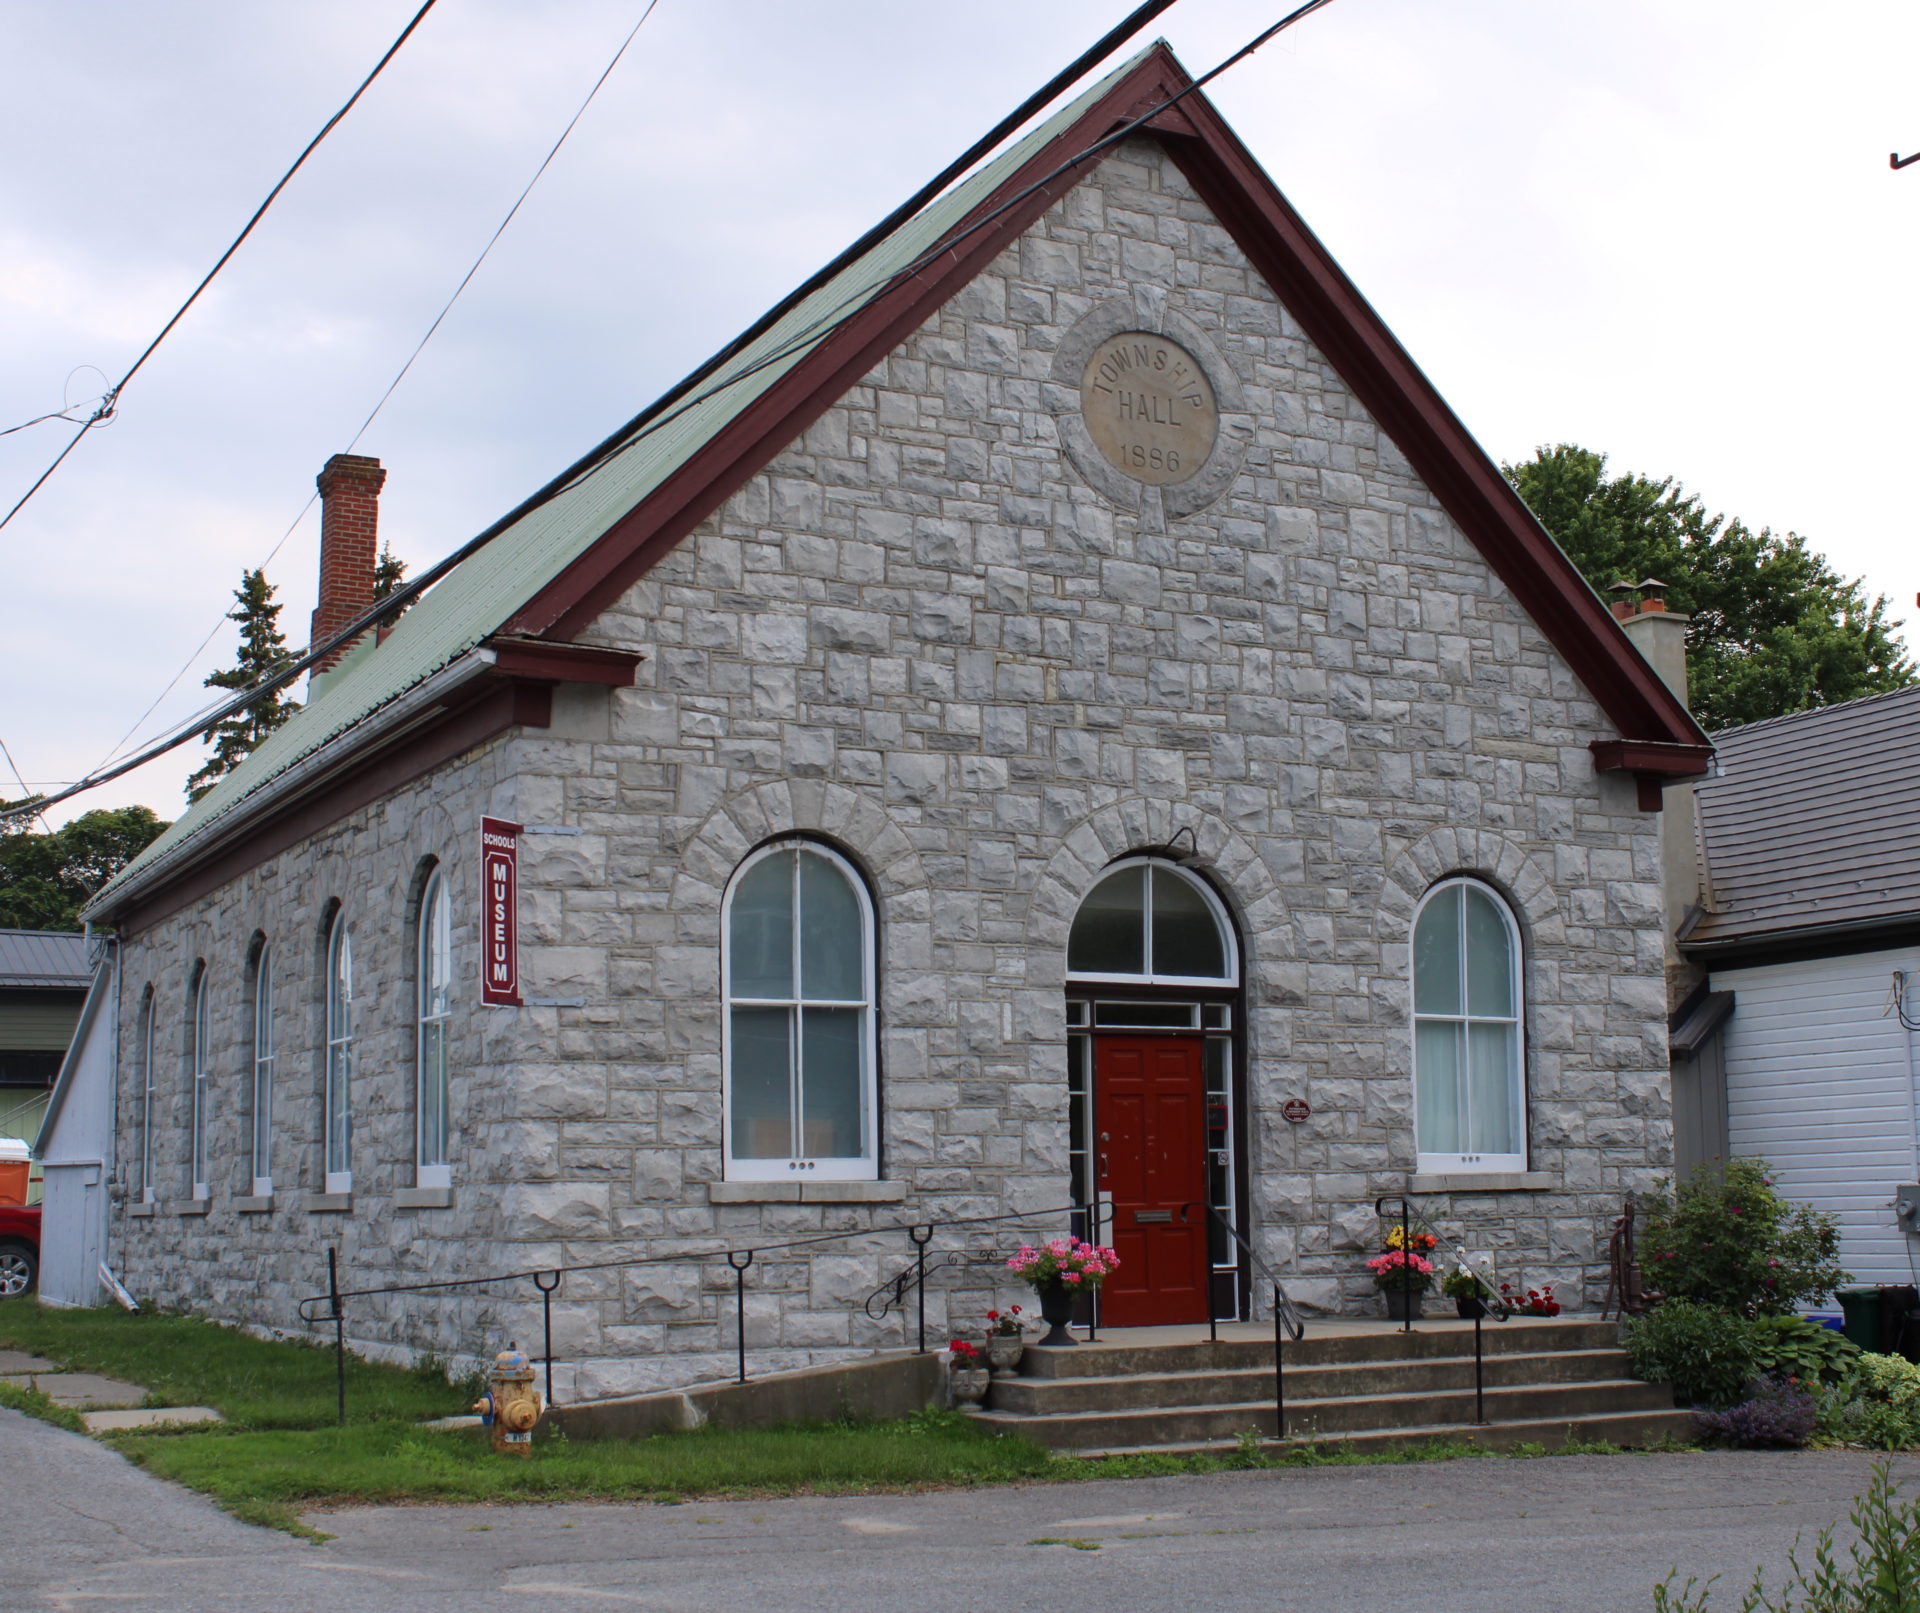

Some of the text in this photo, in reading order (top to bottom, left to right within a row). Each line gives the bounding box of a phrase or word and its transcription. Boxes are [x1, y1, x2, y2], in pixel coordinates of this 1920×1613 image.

[1092, 345, 1203, 408] TOWNSHIP
[1118, 390, 1182, 426] HALL
[1121, 444, 1180, 472] 1886
[484, 832, 515, 849] SCHOOLS
[493, 863, 507, 981] MUSEUM
